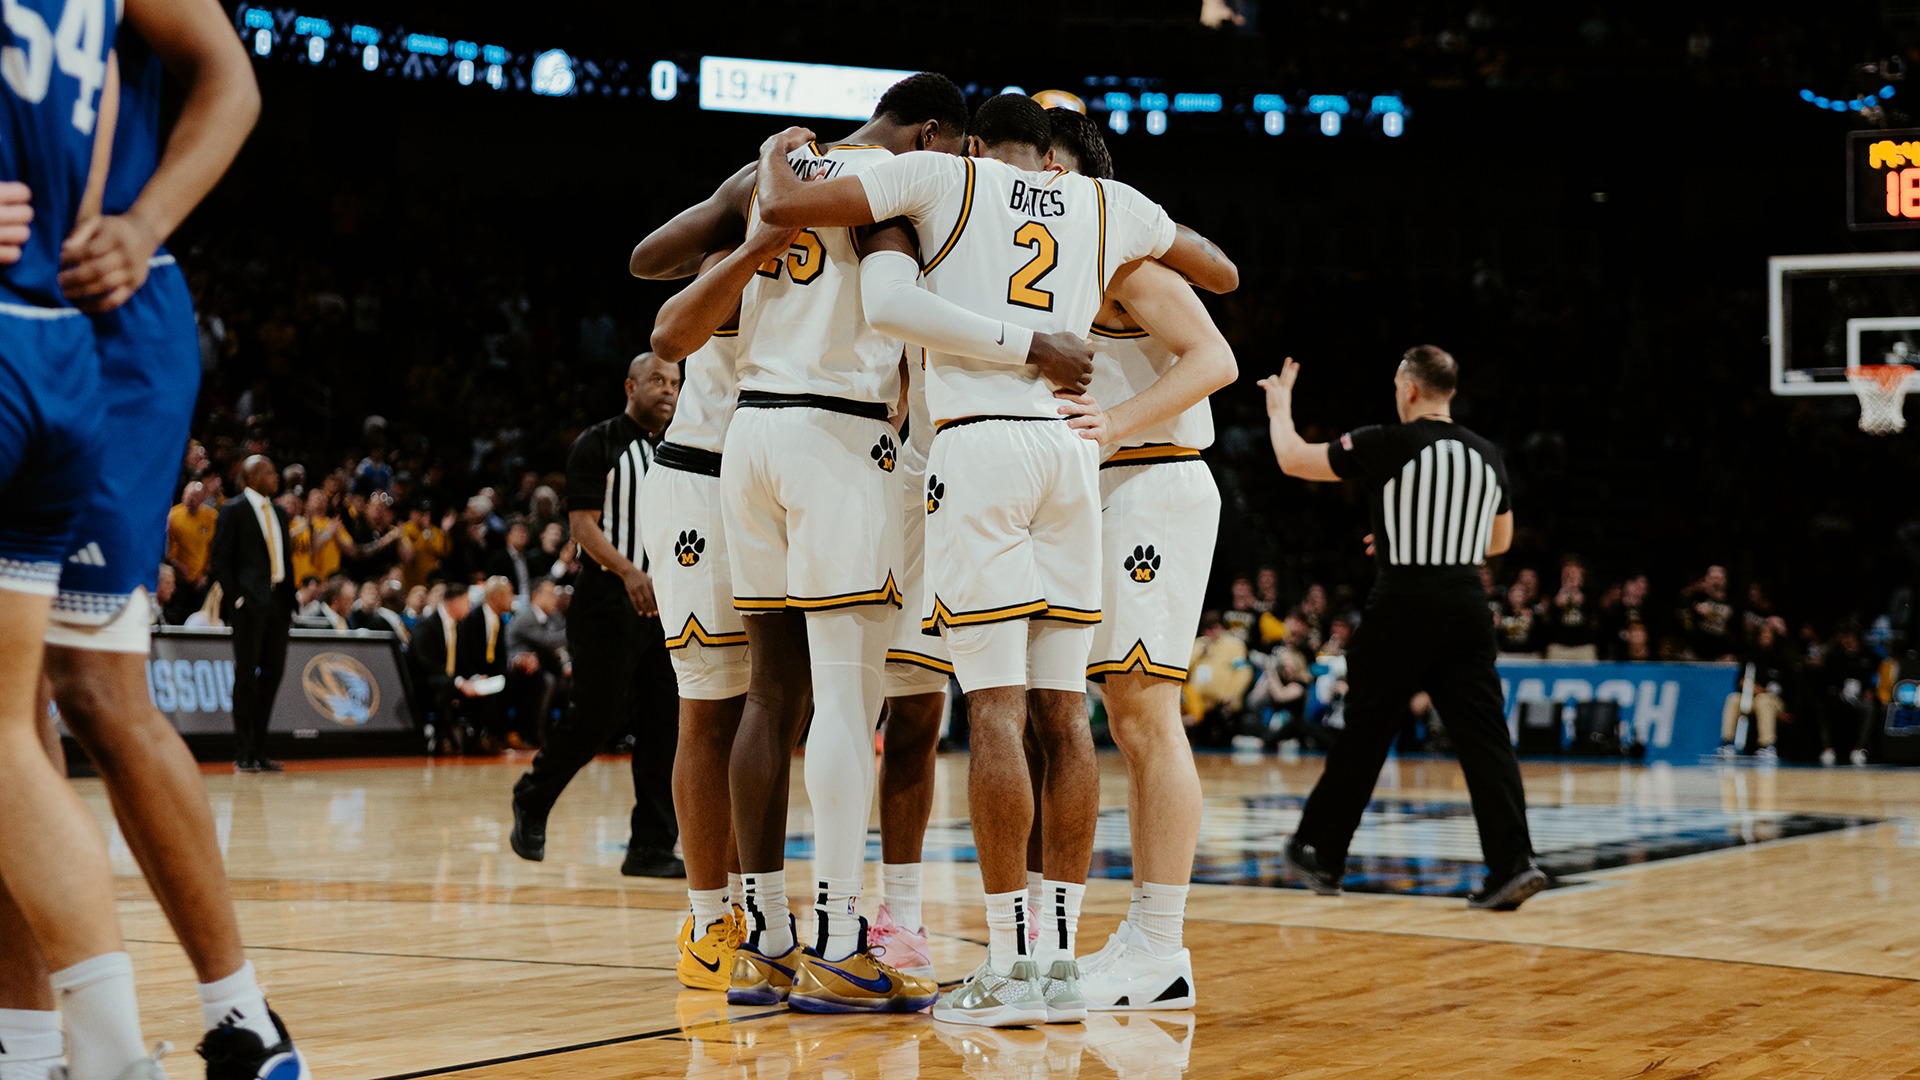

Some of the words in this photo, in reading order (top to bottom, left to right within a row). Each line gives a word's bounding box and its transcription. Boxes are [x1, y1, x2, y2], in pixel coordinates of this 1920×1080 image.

[651, 60, 678, 101] 0
[1009, 179, 1066, 218] BATES
[1006, 219, 1059, 313] 2
[681, 552, 695, 565] M
[1135, 568, 1152, 581] M
